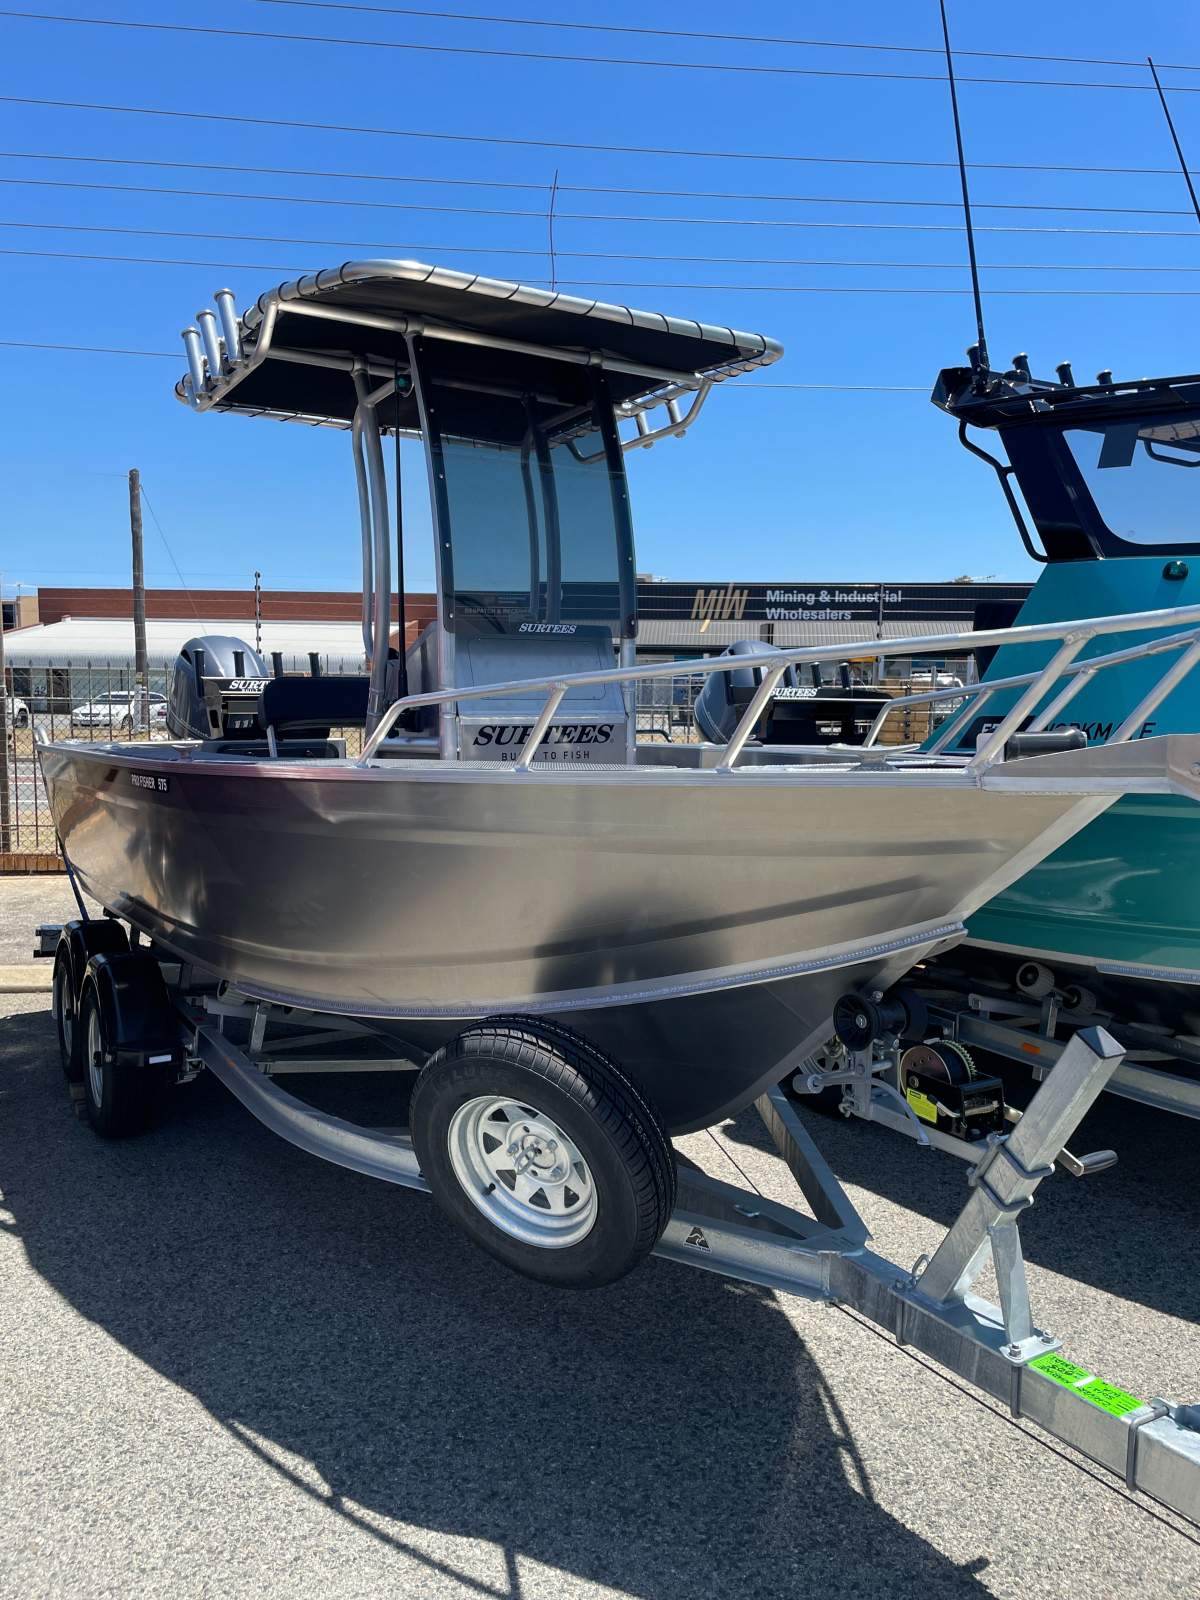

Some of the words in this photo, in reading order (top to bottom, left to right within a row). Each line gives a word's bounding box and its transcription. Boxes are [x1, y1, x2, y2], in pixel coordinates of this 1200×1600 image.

[766, 590, 815, 605] Mining
[818, 590, 831, 603] &
[834, 590, 902, 603] Industrial
[766, 607, 852, 620] Wholesalers
[518, 622, 577, 634] SURTEES
[229, 680, 270, 690] SURT
[770, 687, 818, 697] SURTEES
[501, 752, 537, 762] BUT
[543, 751, 557, 760] TO
[563, 750, 590, 760] FISH
[157, 778, 168, 791] 575
